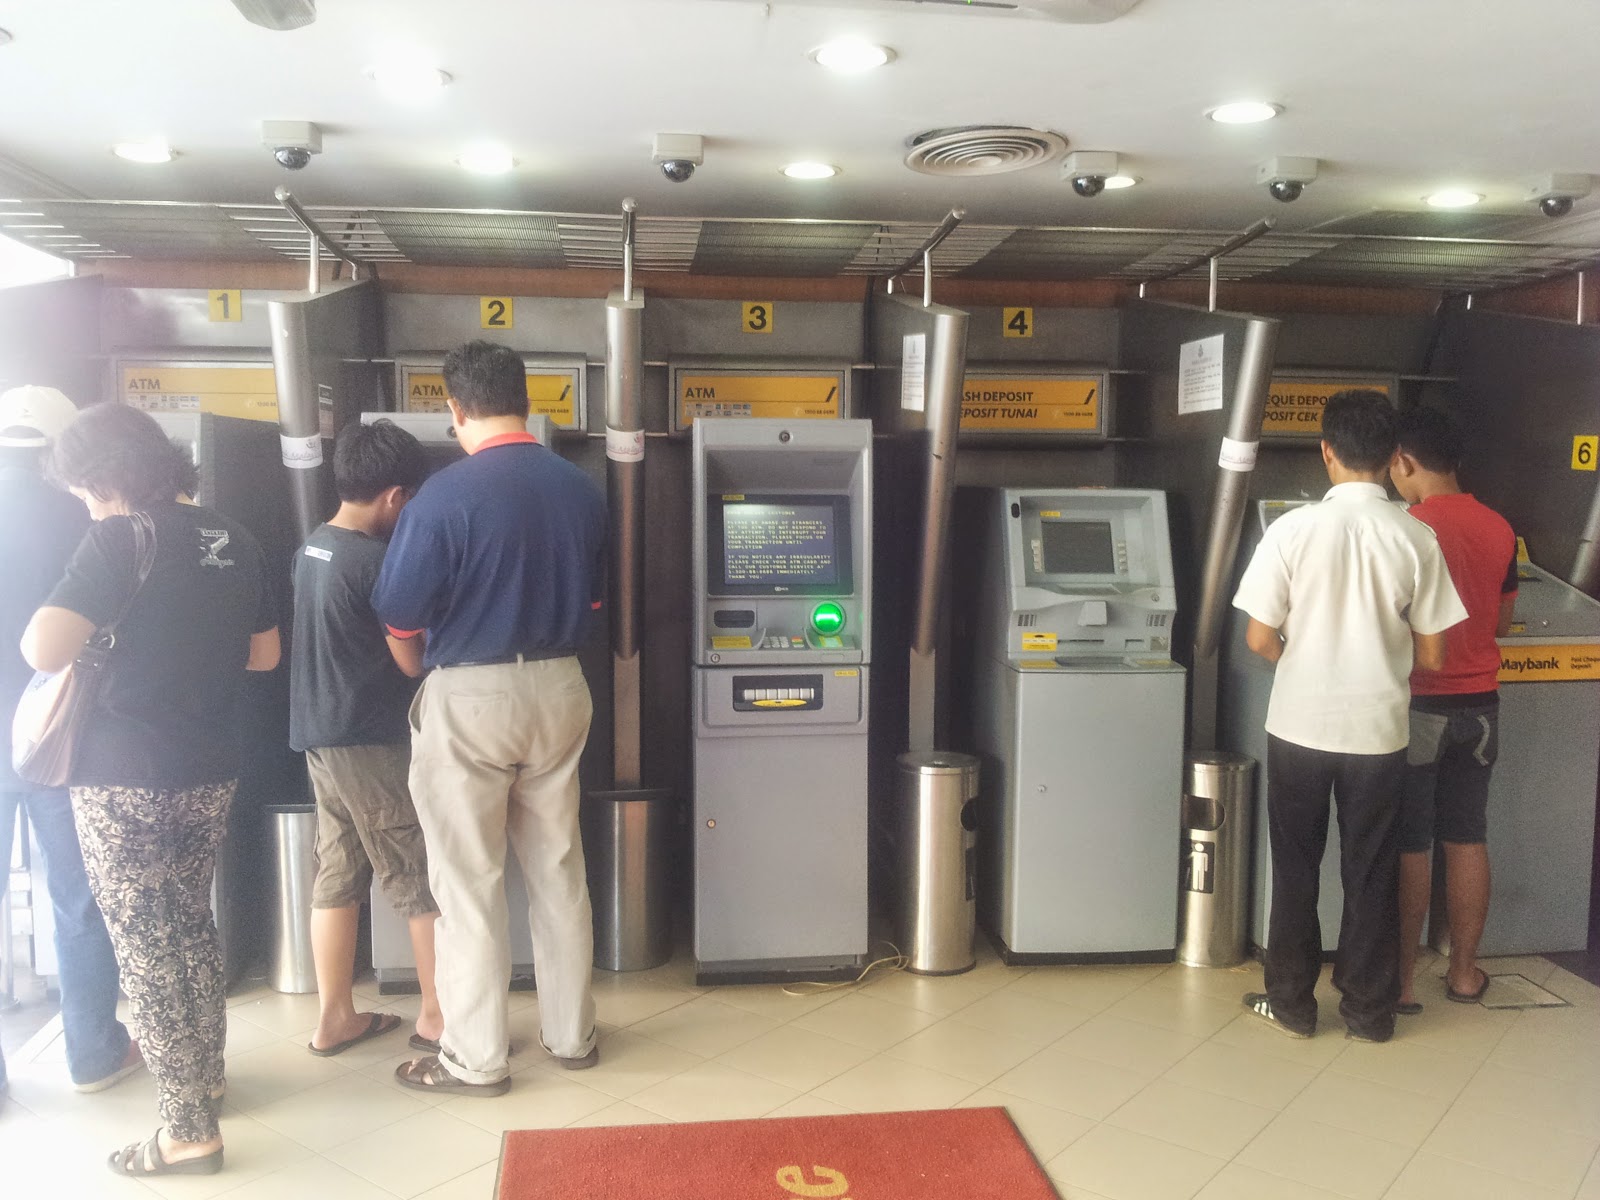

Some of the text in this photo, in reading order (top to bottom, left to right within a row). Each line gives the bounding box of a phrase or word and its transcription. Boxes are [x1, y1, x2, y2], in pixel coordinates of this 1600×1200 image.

[217, 293, 229, 319] 1
[488, 300, 505, 325] 2
[749, 306, 766, 330] 3
[1008, 311, 1028, 335] 4
[128, 378, 160, 390] ATM
[412, 385, 443, 396] ATM
[685, 387, 715, 398] ATM
[963, 392, 1034, 402] SH DEPOSIT
[1001, 408, 1038, 419] TUNAI
[1297, 411, 1318, 422] CEK
[1578, 442, 1591, 464] 6
[1501, 656, 1560, 673] Maybank
